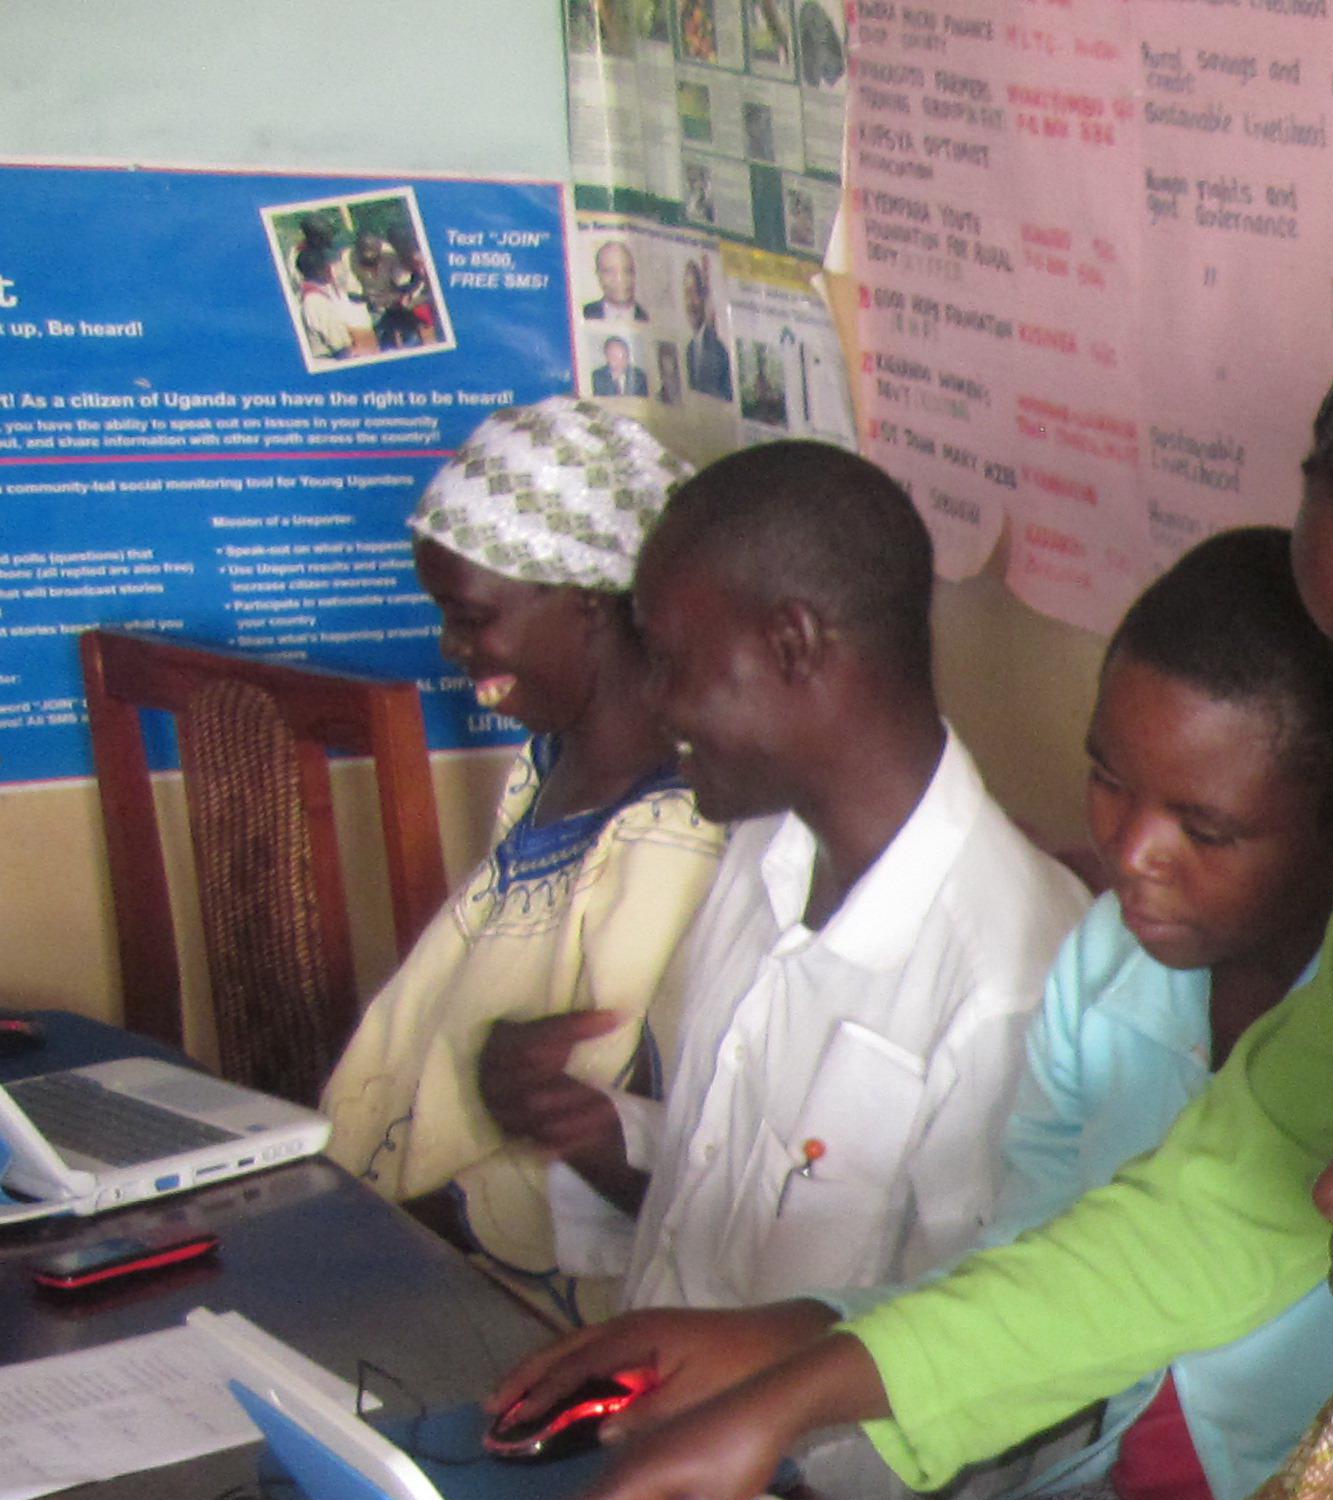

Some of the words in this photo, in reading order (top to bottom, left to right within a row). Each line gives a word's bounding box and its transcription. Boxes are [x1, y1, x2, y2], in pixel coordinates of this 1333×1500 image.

[446, 229, 484, 247] Text
[447, 252, 467, 267] to
[449, 271, 500, 289] FREE
[502, 272, 550, 290] SMS!
[11, 320, 43, 339] up,
[47, 319, 76, 337] Be
[79, 319, 144, 338] heard!
[20, 392, 48, 410] As
[52, 396, 66, 409] a
[69, 392, 135, 409] citizen
[139, 392, 159, 409] of
[163, 392, 237, 412] Uganda
[241, 396, 276, 411] you
[280, 390, 325, 407] have
[330, 390, 359, 406] the
[363, 390, 404, 410] right
[408, 390, 428, 406] to
[431, 389, 452, 405] be
[5, 421, 34, 435] you
[37, 419, 73, 432] have
[76, 418, 100, 431] the
[104, 418, 150, 433] ability
[152, 418, 167, 430] to
[169, 418, 212, 432] speak
[215, 418, 240, 430] out
[330, 417, 363, 431] your
[364, 415, 440, 430] community
[26, 437, 54, 449] and
[58, 436, 99, 448] share
[103, 434, 187, 447] information
[223, 433, 260, 445] other
[263, 431, 304, 447] youth
[355, 431, 379, 443] the
[6, 480, 117, 496] community-led
[165, 477, 243, 492] monitoring
[276, 475, 297, 488] for
[301, 474, 344, 490] Young
